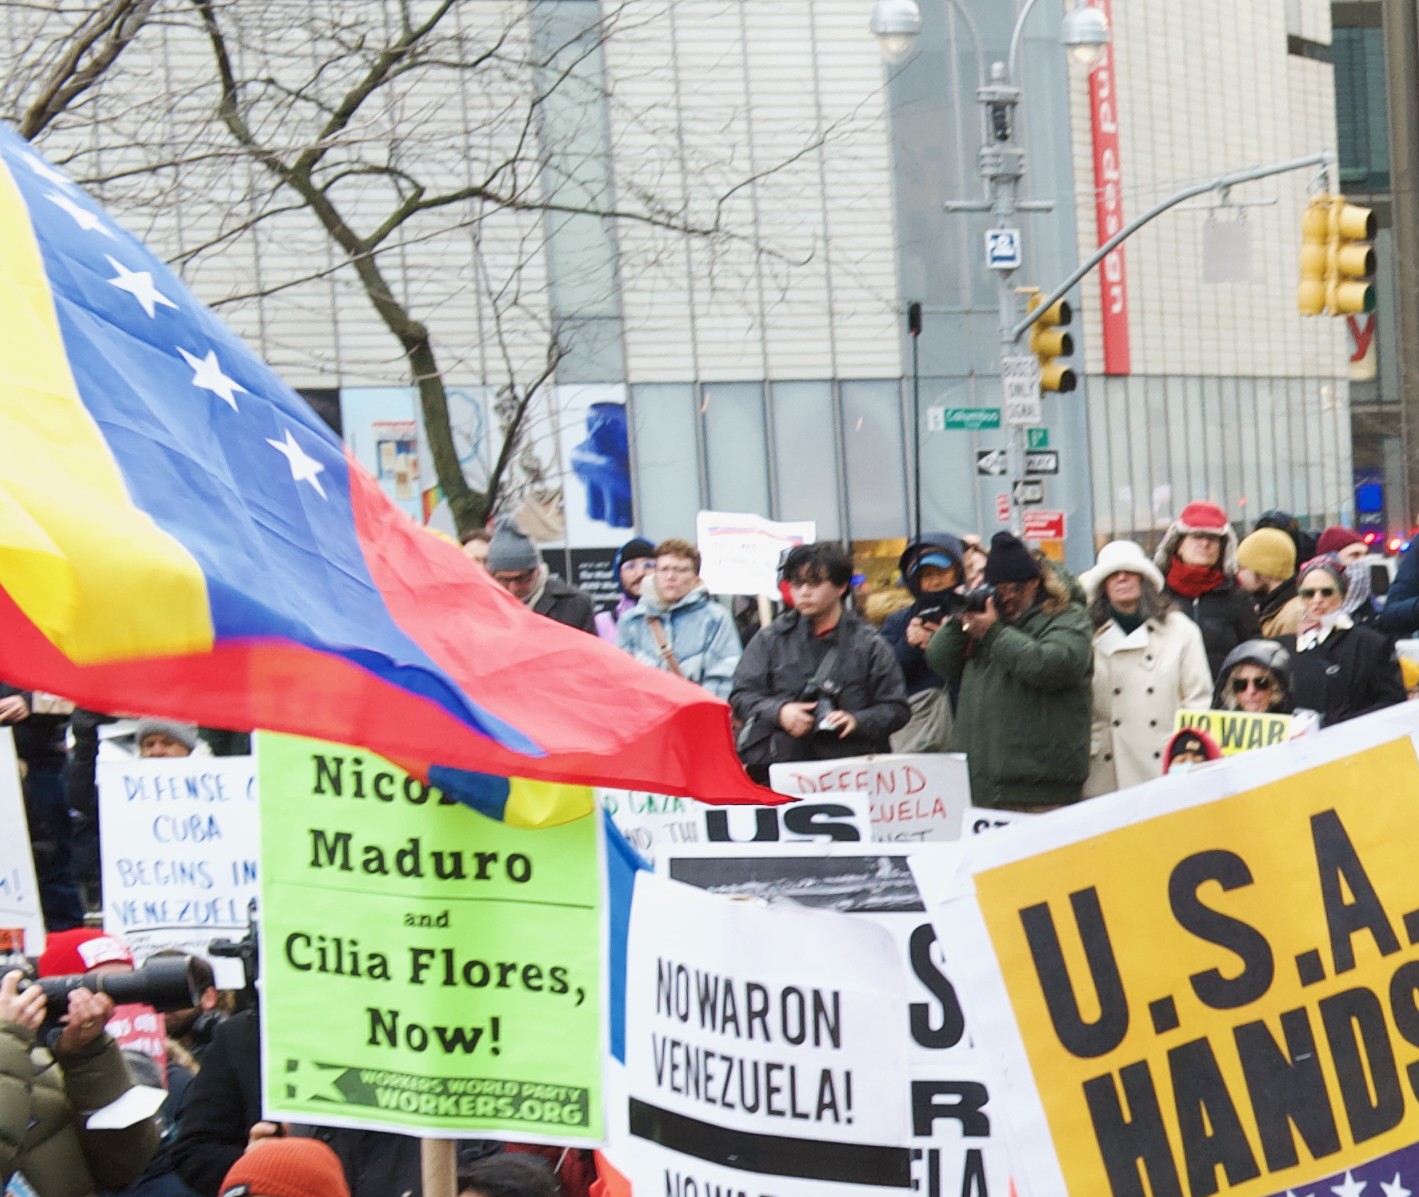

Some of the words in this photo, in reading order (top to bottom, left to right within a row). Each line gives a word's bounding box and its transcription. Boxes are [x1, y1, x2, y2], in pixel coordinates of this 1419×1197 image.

[1101, 148, 1124, 314] desgn
[1221, 717, 1285, 749] WAR
[123, 773, 231, 803] DEFENSE
[312, 755, 458, 807] Nico
[790, 764, 927, 797] DEFEND
[152, 813, 222, 844] CUBA
[116, 858, 215, 890] BEGINS
[310, 829, 533, 884] Maduro
[112, 894, 246, 926] VENEZUEL
[404, 910, 450, 929] and
[285, 932, 392, 982] Cilia
[409, 947, 587, 1008] Flores,
[656, 956, 690, 1023] NO
[694, 968, 771, 1043] WAR
[780, 984, 842, 1050] ON
[366, 1007, 503, 1057] Now!
[359, 1069, 438, 1093] WORKERS
[447, 1079, 518, 1098] WORLD
[521, 1083, 582, 1101] PARTY
[652, 1032, 854, 1125] VENEZUELA!
[376, 1088, 584, 1126] WORKERS.ORG
